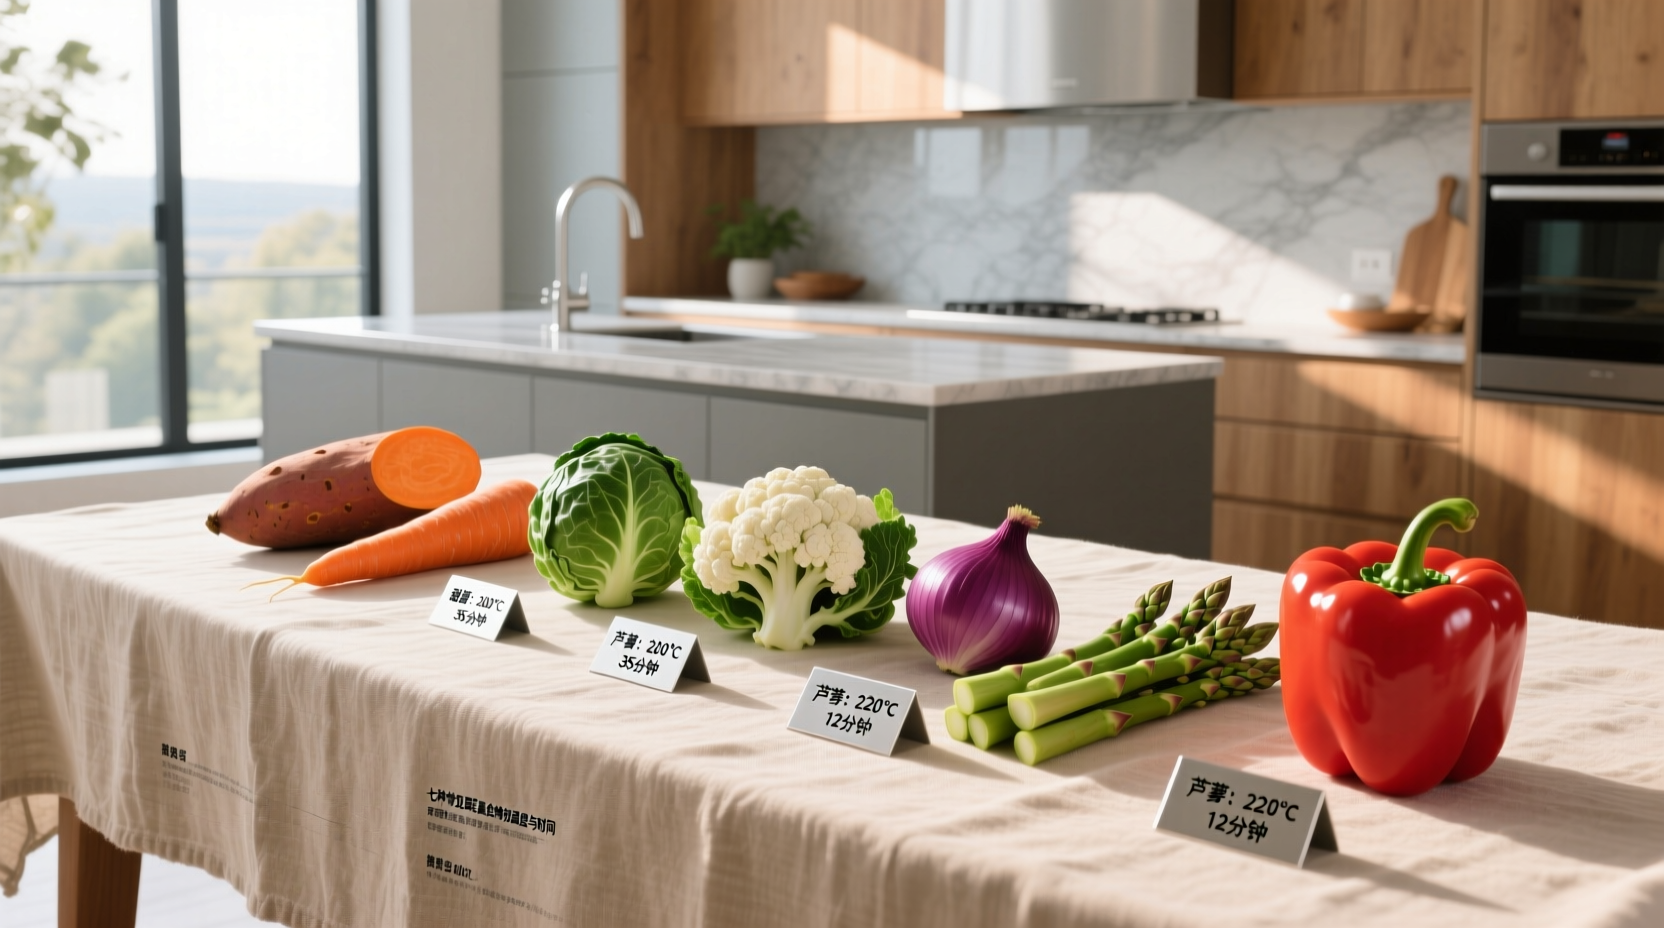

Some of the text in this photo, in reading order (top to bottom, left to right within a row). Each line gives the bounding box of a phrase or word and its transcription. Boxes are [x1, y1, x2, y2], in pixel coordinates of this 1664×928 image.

[618, 654, 660, 676] 35分钟
[825, 711, 872, 736] 12分钟
[1208, 811, 1269, 843] 12分钟
